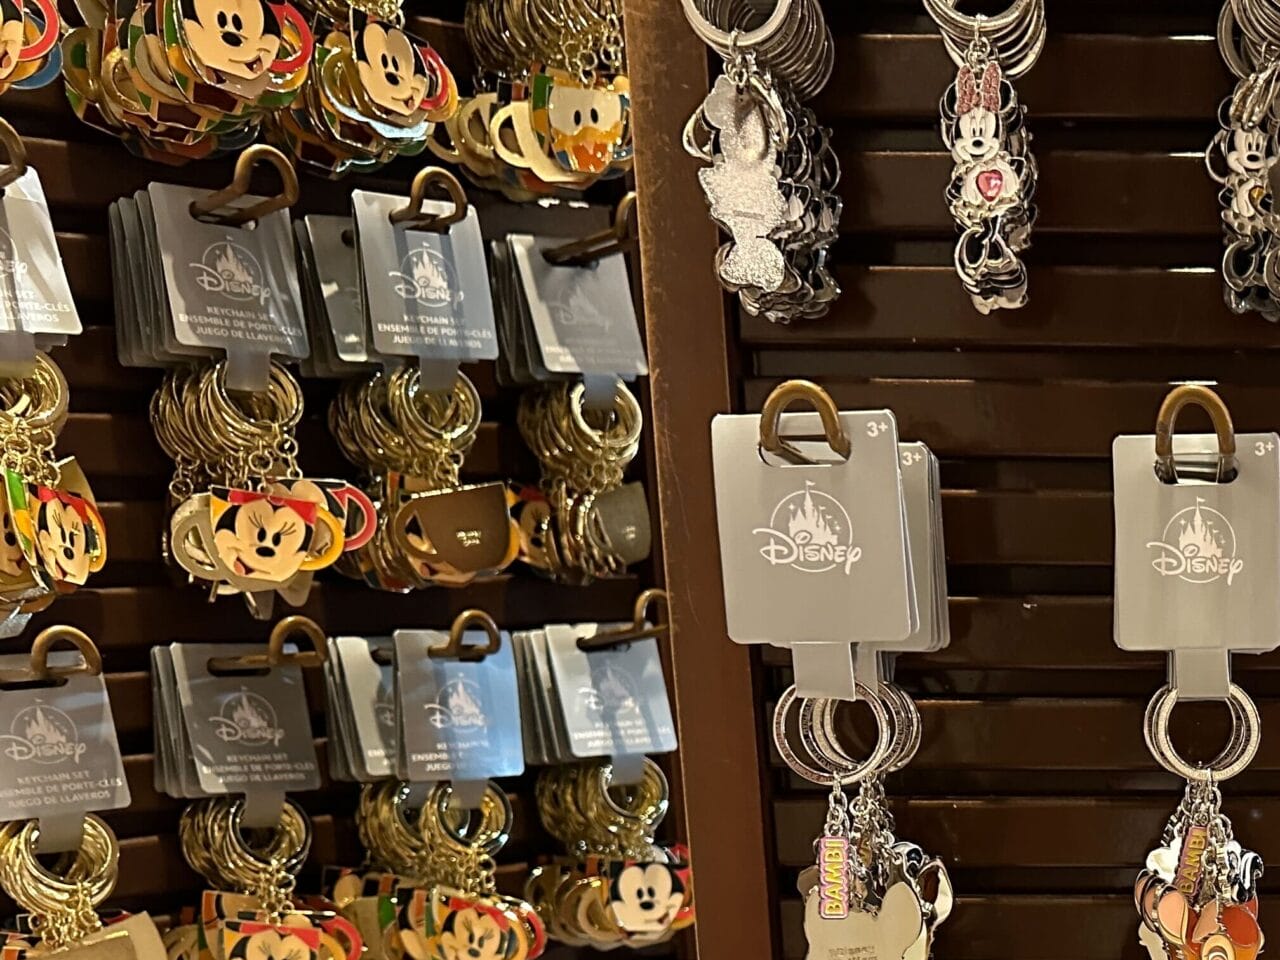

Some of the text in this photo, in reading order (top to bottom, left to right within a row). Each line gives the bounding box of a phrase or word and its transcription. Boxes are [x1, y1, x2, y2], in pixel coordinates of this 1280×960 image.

[231, 320, 246, 330] DE
[231, 330, 245, 339] DE
[866, 421, 888, 438] 3+
[1254, 441, 1275, 456] 3+
[902, 451, 922, 466] 3+
[1179, 829, 1207, 894] BAMBI
[824, 839, 845, 916] BAMBI
